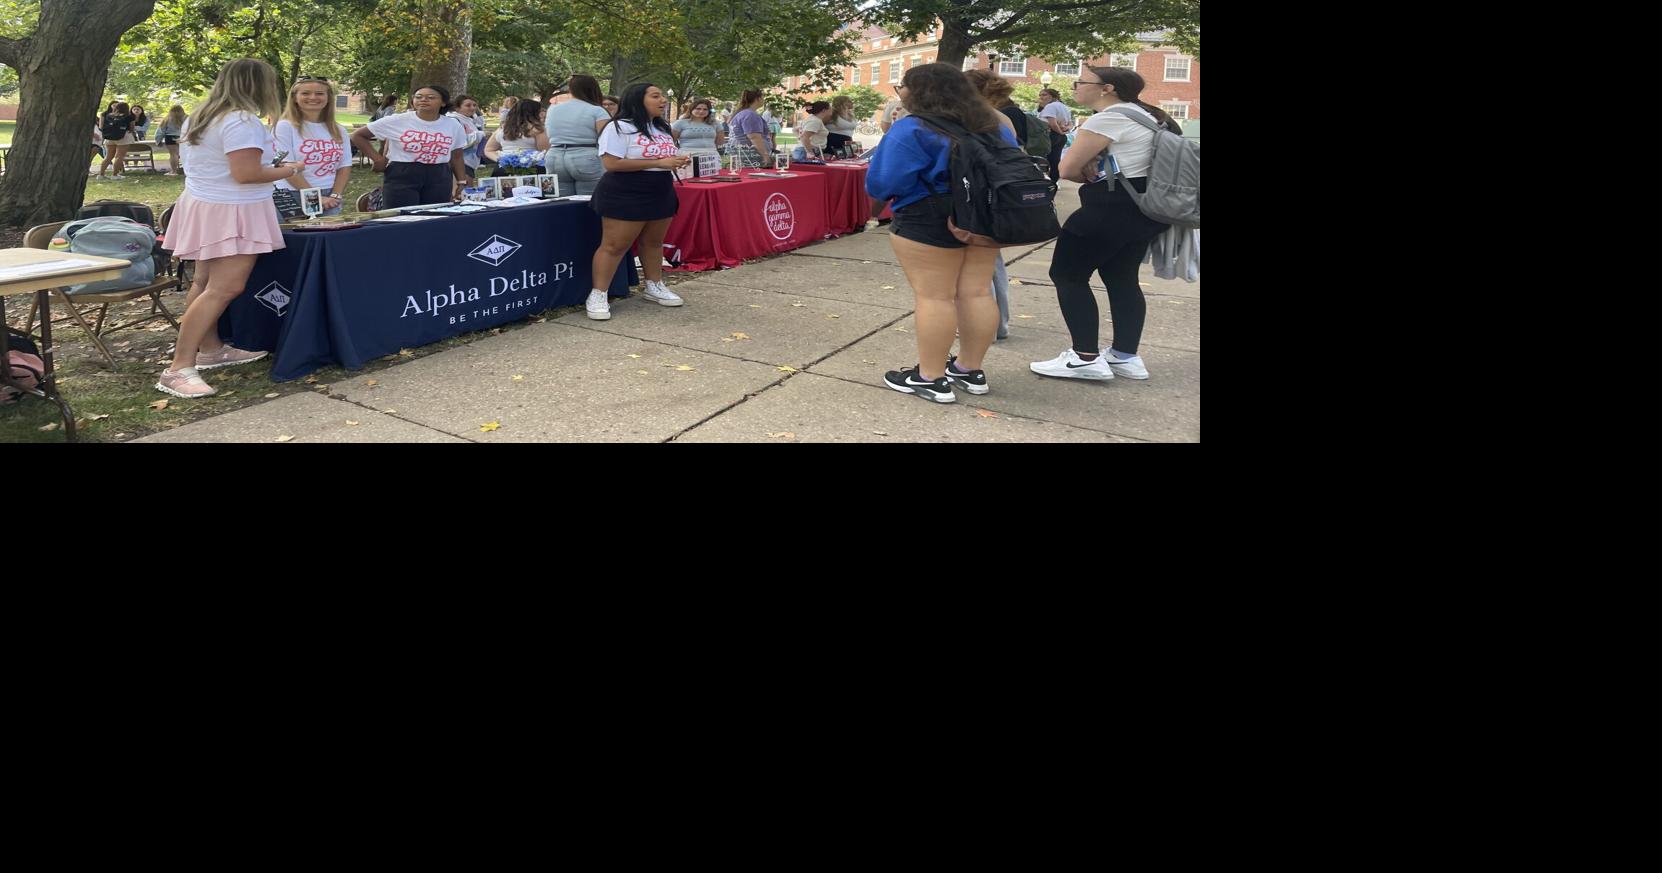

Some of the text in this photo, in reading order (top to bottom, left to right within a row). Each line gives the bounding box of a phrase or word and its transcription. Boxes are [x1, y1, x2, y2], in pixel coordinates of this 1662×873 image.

[400, 130, 453, 144] Alpha
[404, 141, 450, 155] Delta
[767, 200, 787, 213] alpha
[768, 212, 790, 228] gamma
[400, 261, 574, 317] Alpha Delta Pi
[450, 296, 538, 325] BE THE FIRST
